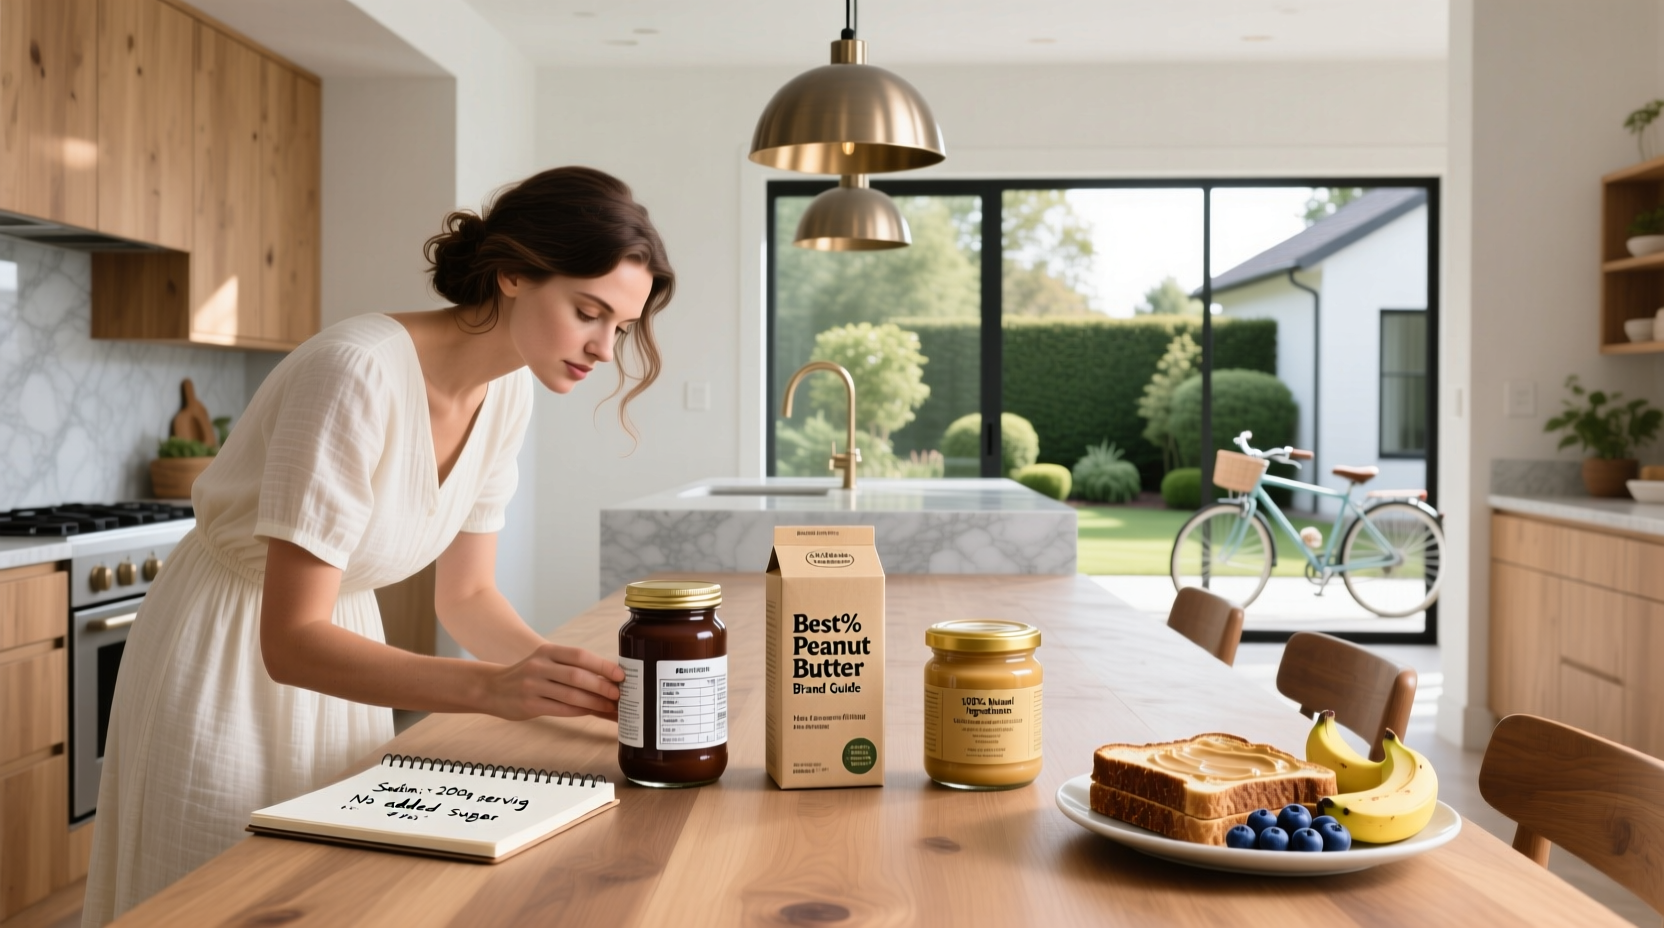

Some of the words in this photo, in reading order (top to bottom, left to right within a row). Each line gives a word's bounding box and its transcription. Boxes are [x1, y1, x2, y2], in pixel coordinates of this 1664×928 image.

[793, 613, 862, 634] Best%
[793, 636, 871, 656] Peanut
[793, 658, 865, 679] Butter
[793, 682, 826, 695] Brand
[829, 682, 861, 694] Guide
[349, 794, 375, 805] No
[384, 798, 442, 813] added
